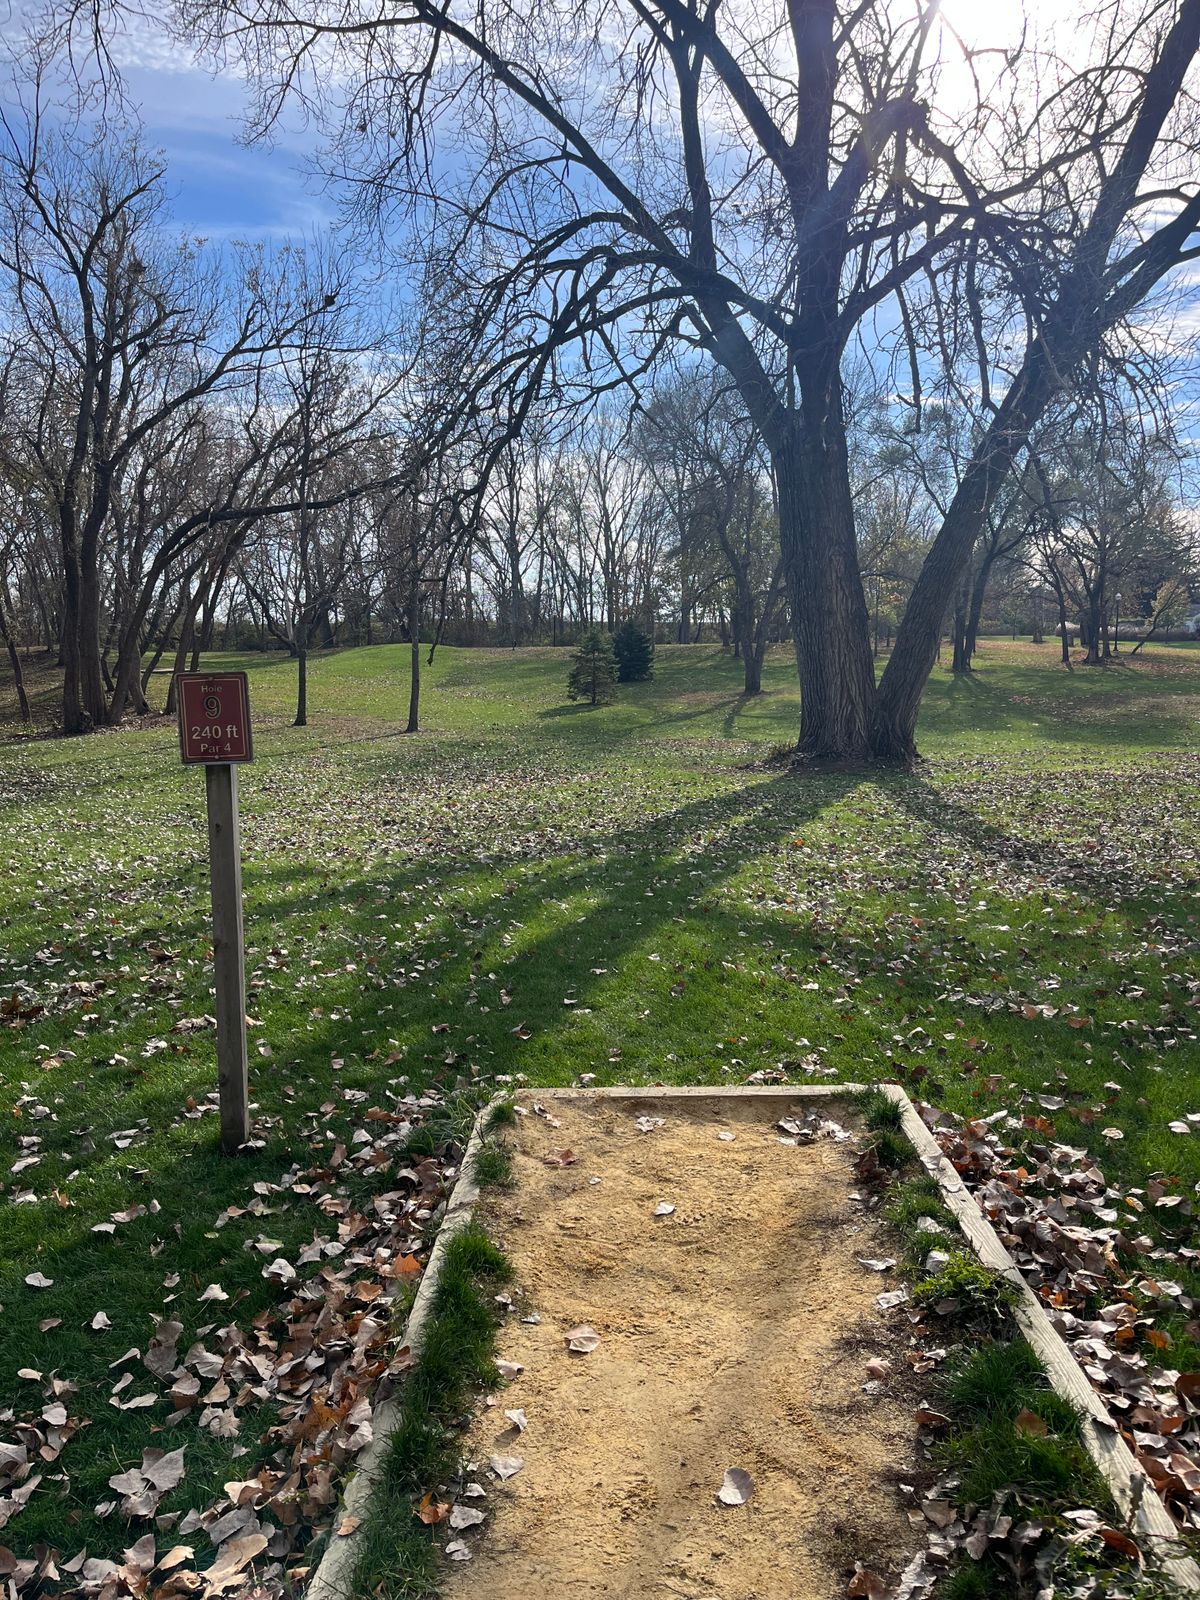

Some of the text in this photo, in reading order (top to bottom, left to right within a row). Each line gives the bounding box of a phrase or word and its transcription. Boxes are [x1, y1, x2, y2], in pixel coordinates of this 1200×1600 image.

[201, 685, 223, 693] Hole
[204, 695, 222, 720] 9
[191, 724, 239, 740] 240 ft
[200, 742, 232, 753] Par 4
